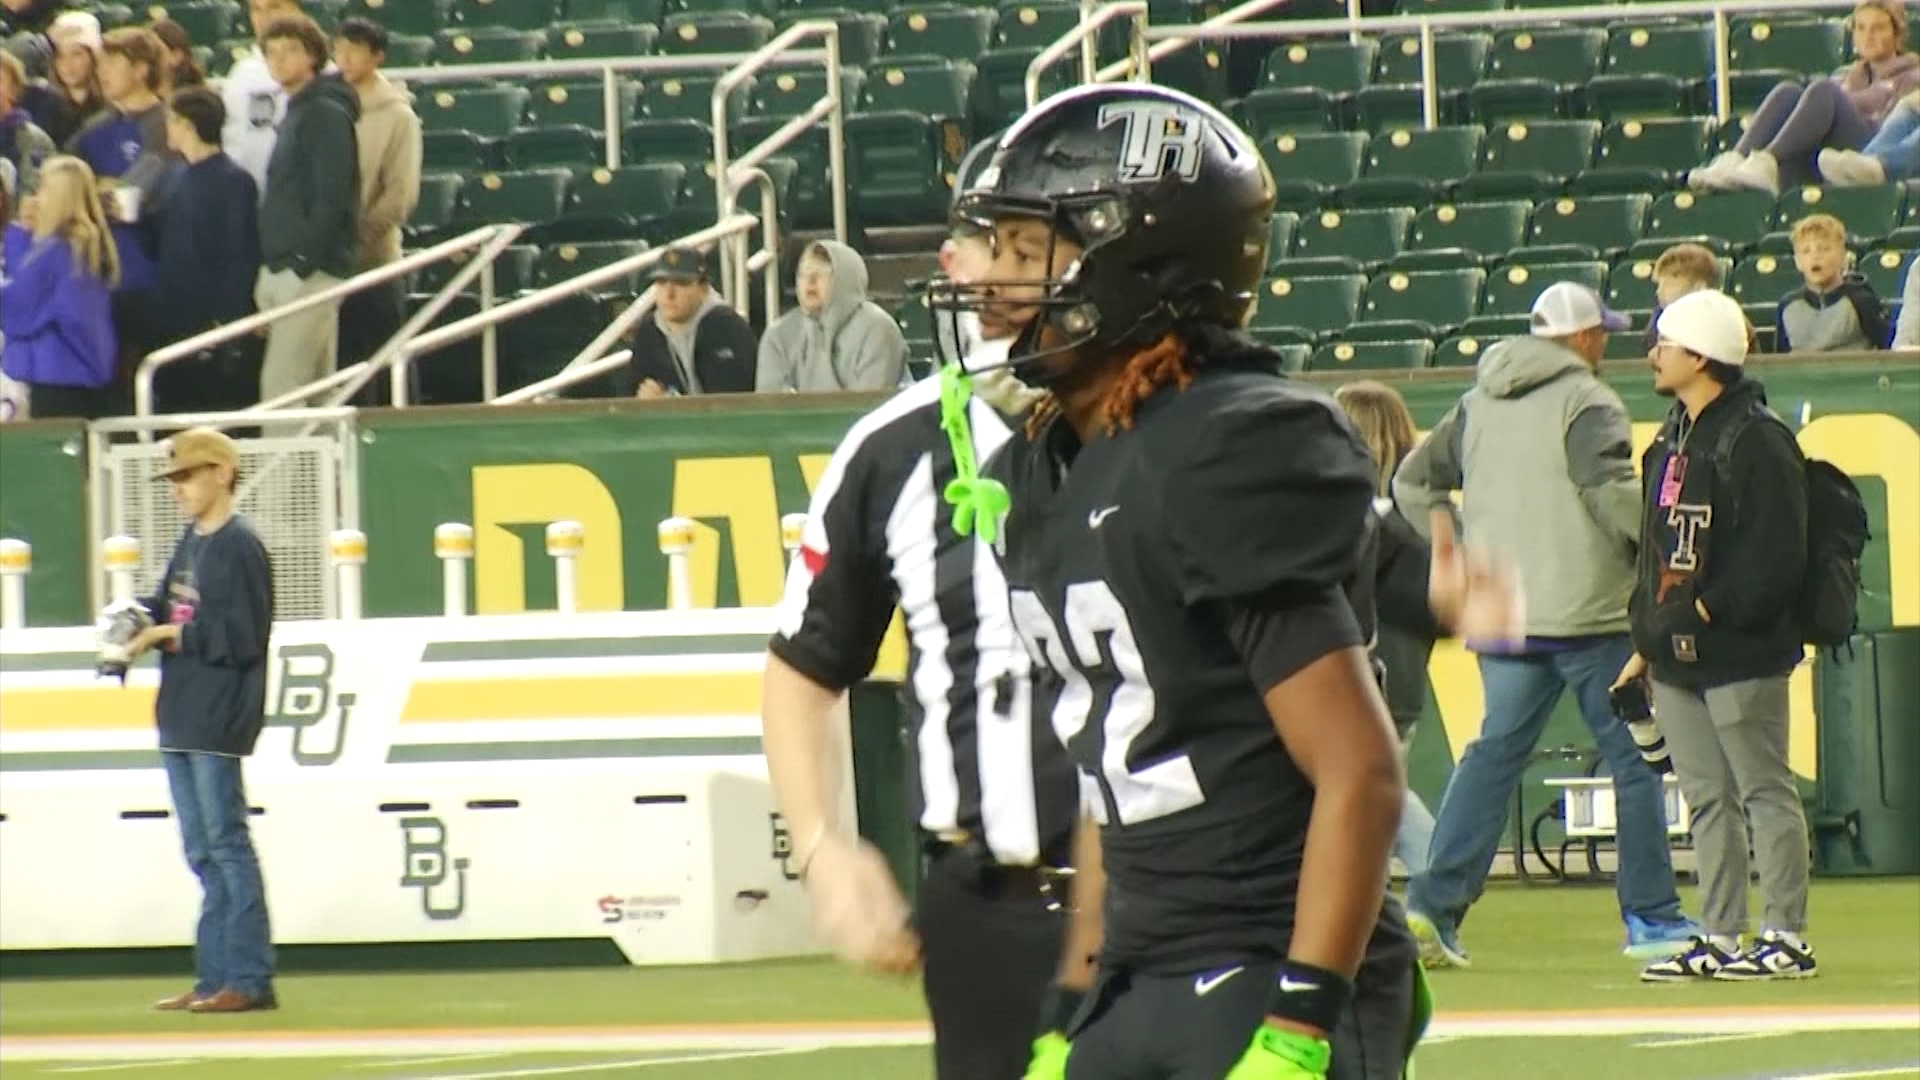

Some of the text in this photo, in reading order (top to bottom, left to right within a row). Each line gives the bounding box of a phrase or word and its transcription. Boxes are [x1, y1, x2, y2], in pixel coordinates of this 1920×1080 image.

[1098, 101, 1205, 184] TR
[1667, 503, 1712, 571] T
[265, 643, 357, 766] BU
[1009, 579, 1206, 826] 22
[399, 816, 471, 920] BU
